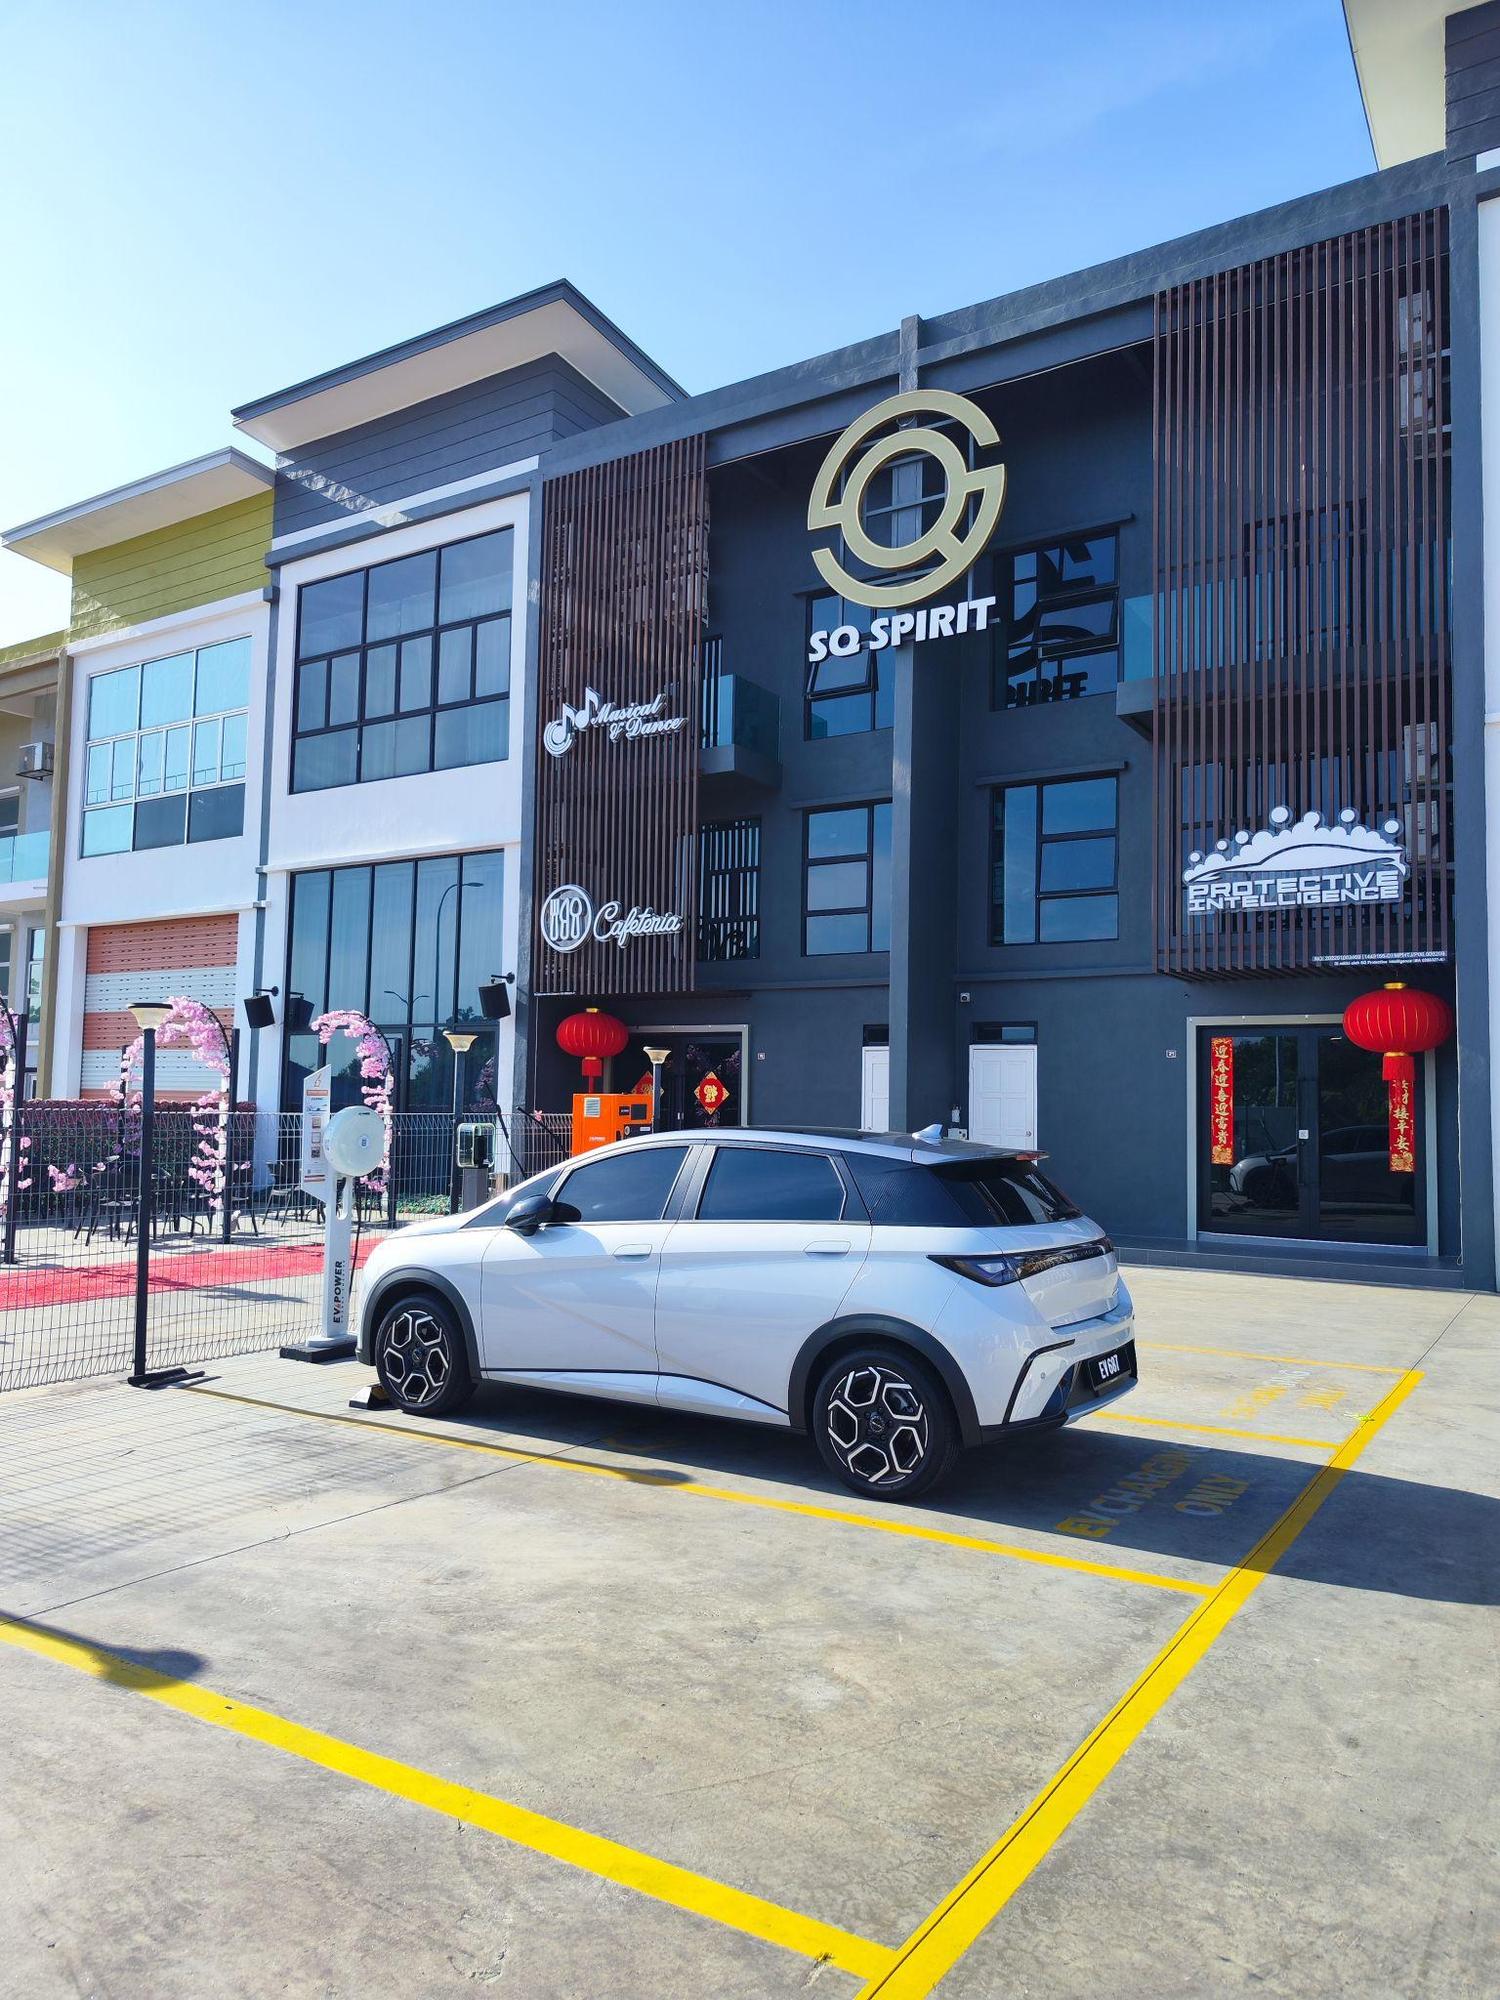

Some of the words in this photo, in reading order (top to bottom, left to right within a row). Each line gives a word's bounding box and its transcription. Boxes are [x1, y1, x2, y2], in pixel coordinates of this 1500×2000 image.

[808, 625, 861, 662] SQ
[869, 596, 996, 650] SPIRIT
[591, 693, 664, 726] Musical
[609, 722, 625, 742] &
[625, 717, 687, 740] Dance
[1188, 869, 1400, 899] PROTECTIVE
[1188, 885, 1400, 912] INTELLIGENCE
[593, 901, 683, 948] Cafeteria
[1174, 1473, 1250, 1517] ONLY
